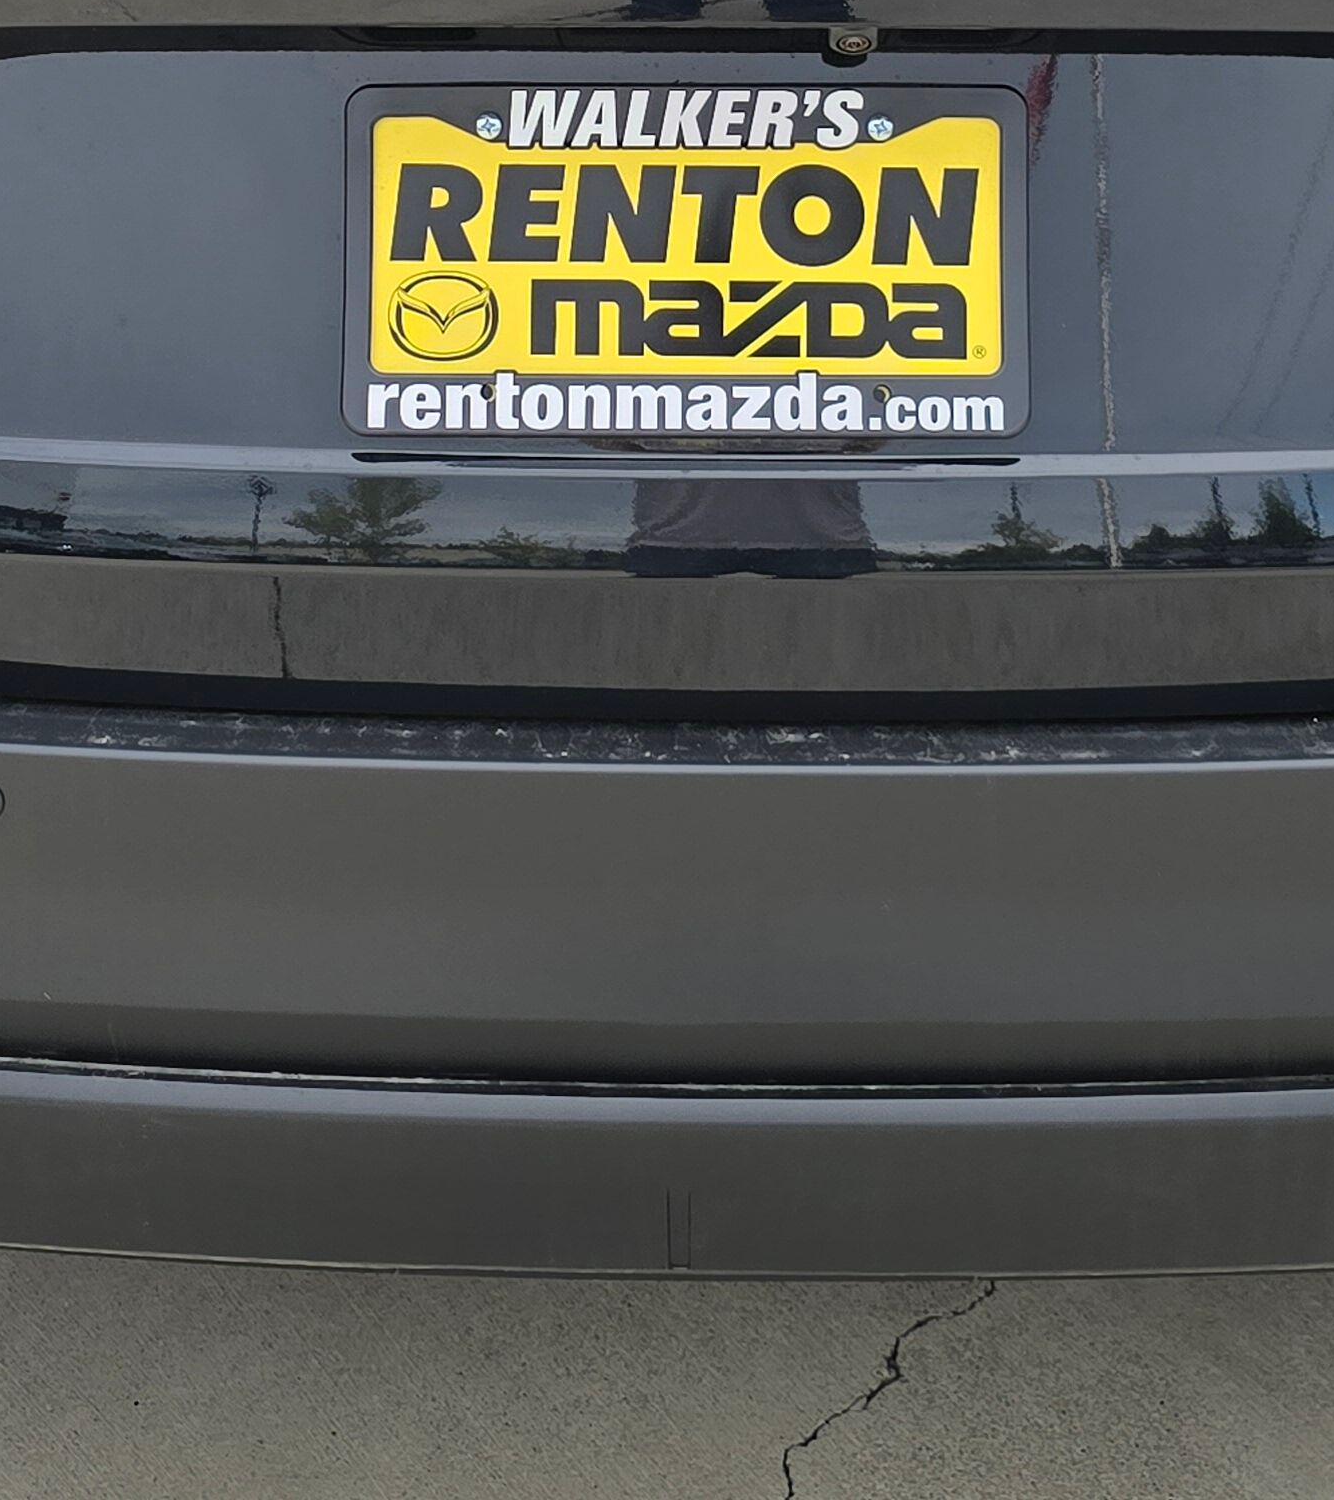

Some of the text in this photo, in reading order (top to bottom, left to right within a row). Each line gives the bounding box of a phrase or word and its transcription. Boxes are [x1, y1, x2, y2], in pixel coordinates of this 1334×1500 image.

[508, 89, 865, 149] WALKER'S
[390, 163, 979, 267] RENTON
[367, 372, 1005, 432] rentonmazda.com
